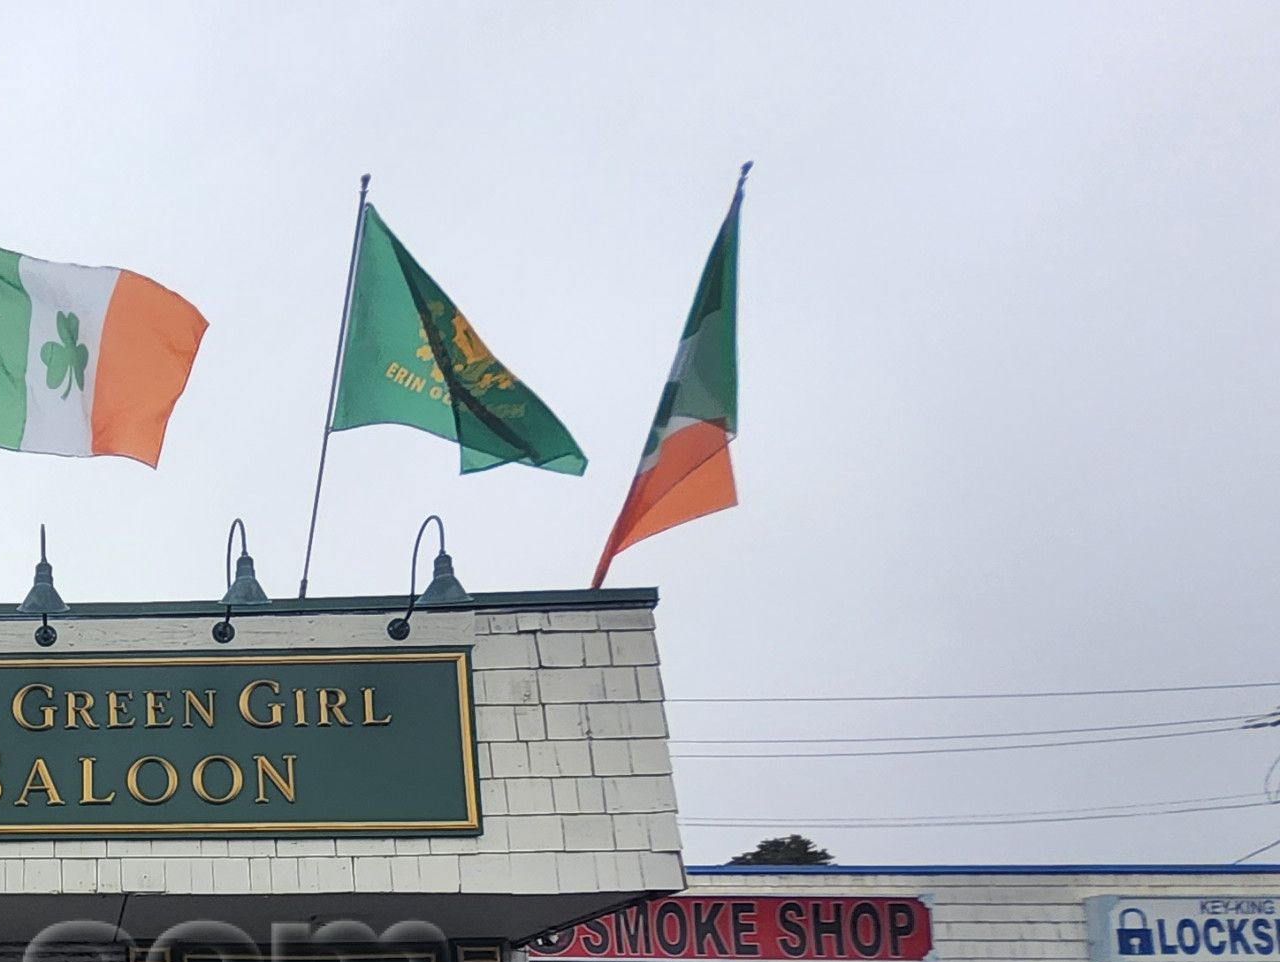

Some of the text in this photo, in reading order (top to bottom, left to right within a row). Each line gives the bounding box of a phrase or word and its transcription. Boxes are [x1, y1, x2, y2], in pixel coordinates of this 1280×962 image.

[385, 361, 426, 394] ERIN
[11, 682, 217, 731] GREEN
[237, 679, 393, 728] GIRL
[1199, 900, 1276, 915] KEY-KING
[580, 901, 916, 958] SMOKE SHOP
